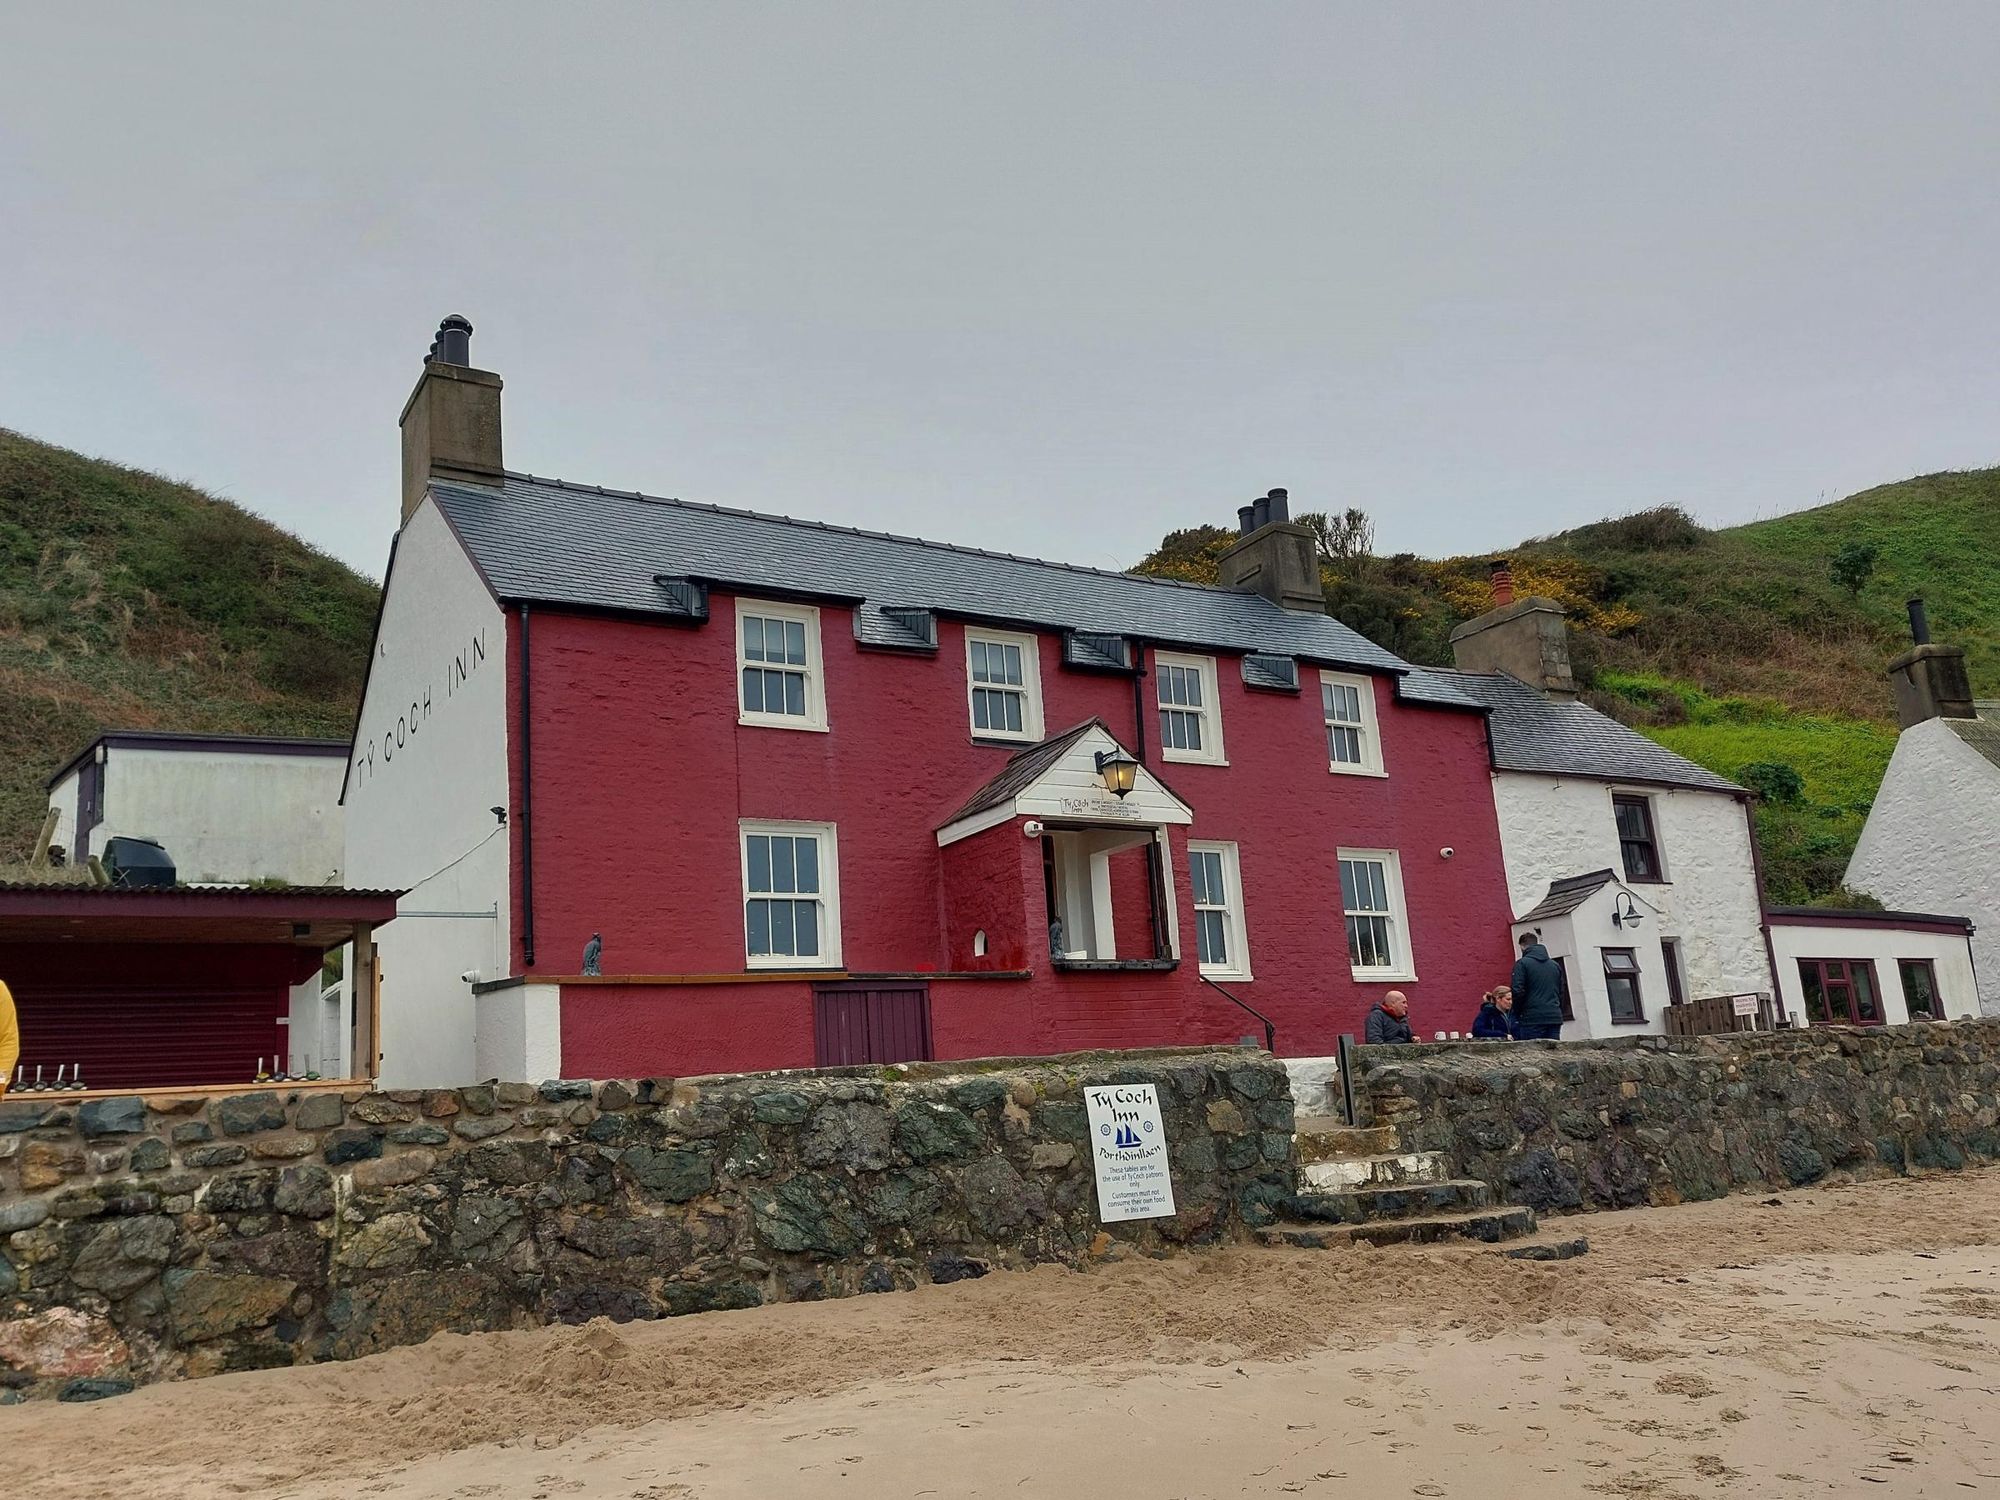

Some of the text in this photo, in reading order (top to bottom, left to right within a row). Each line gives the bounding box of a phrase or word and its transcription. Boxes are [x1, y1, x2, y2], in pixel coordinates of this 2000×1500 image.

[384, 685, 432, 763] COCH
[448, 627, 485, 698] INN
[1115, 1088, 1152, 1105] Coch
[1112, 1109, 1140, 1122] Inn
[1099, 1145, 1161, 1161] Porthdinllaen
[1124, 1165, 1139, 1173] tables
[1122, 1173, 1127, 1181] of
[1133, 1172, 1145, 1180] Coch
[1145, 1171, 1164, 1180] patrons
[1111, 1191, 1139, 1200] Customers
[1132, 1198, 1143, 1206] their
